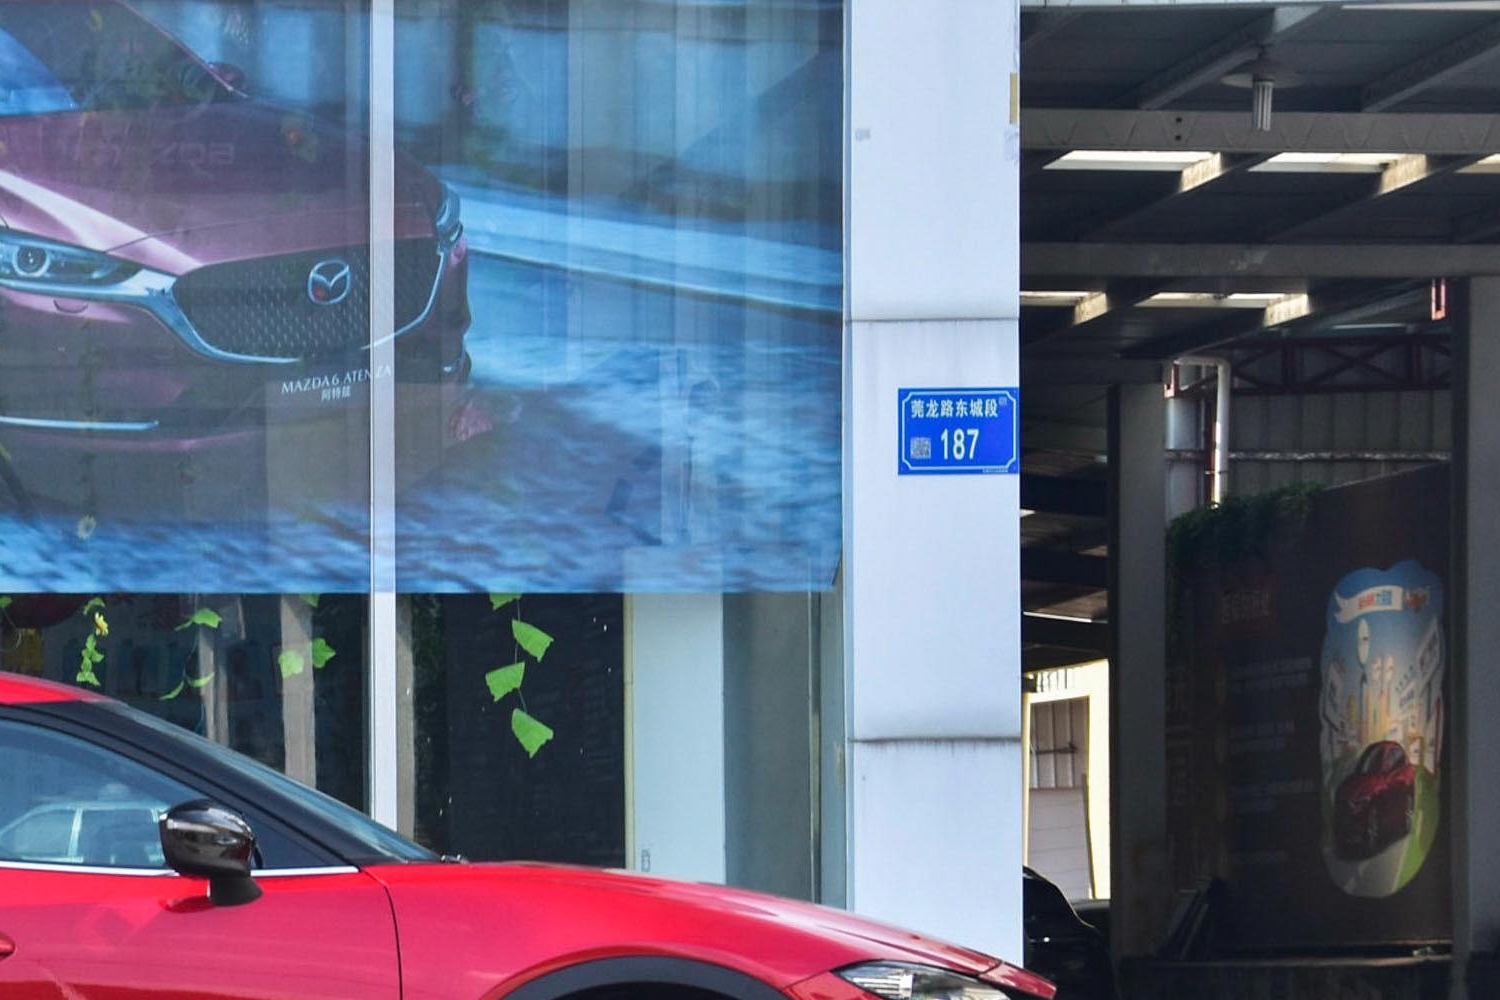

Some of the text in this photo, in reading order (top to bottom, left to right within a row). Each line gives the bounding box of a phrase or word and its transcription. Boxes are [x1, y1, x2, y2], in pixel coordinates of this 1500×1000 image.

[911, 398, 998, 418] 莞龙路东城段
[940, 428, 980, 460] 187
